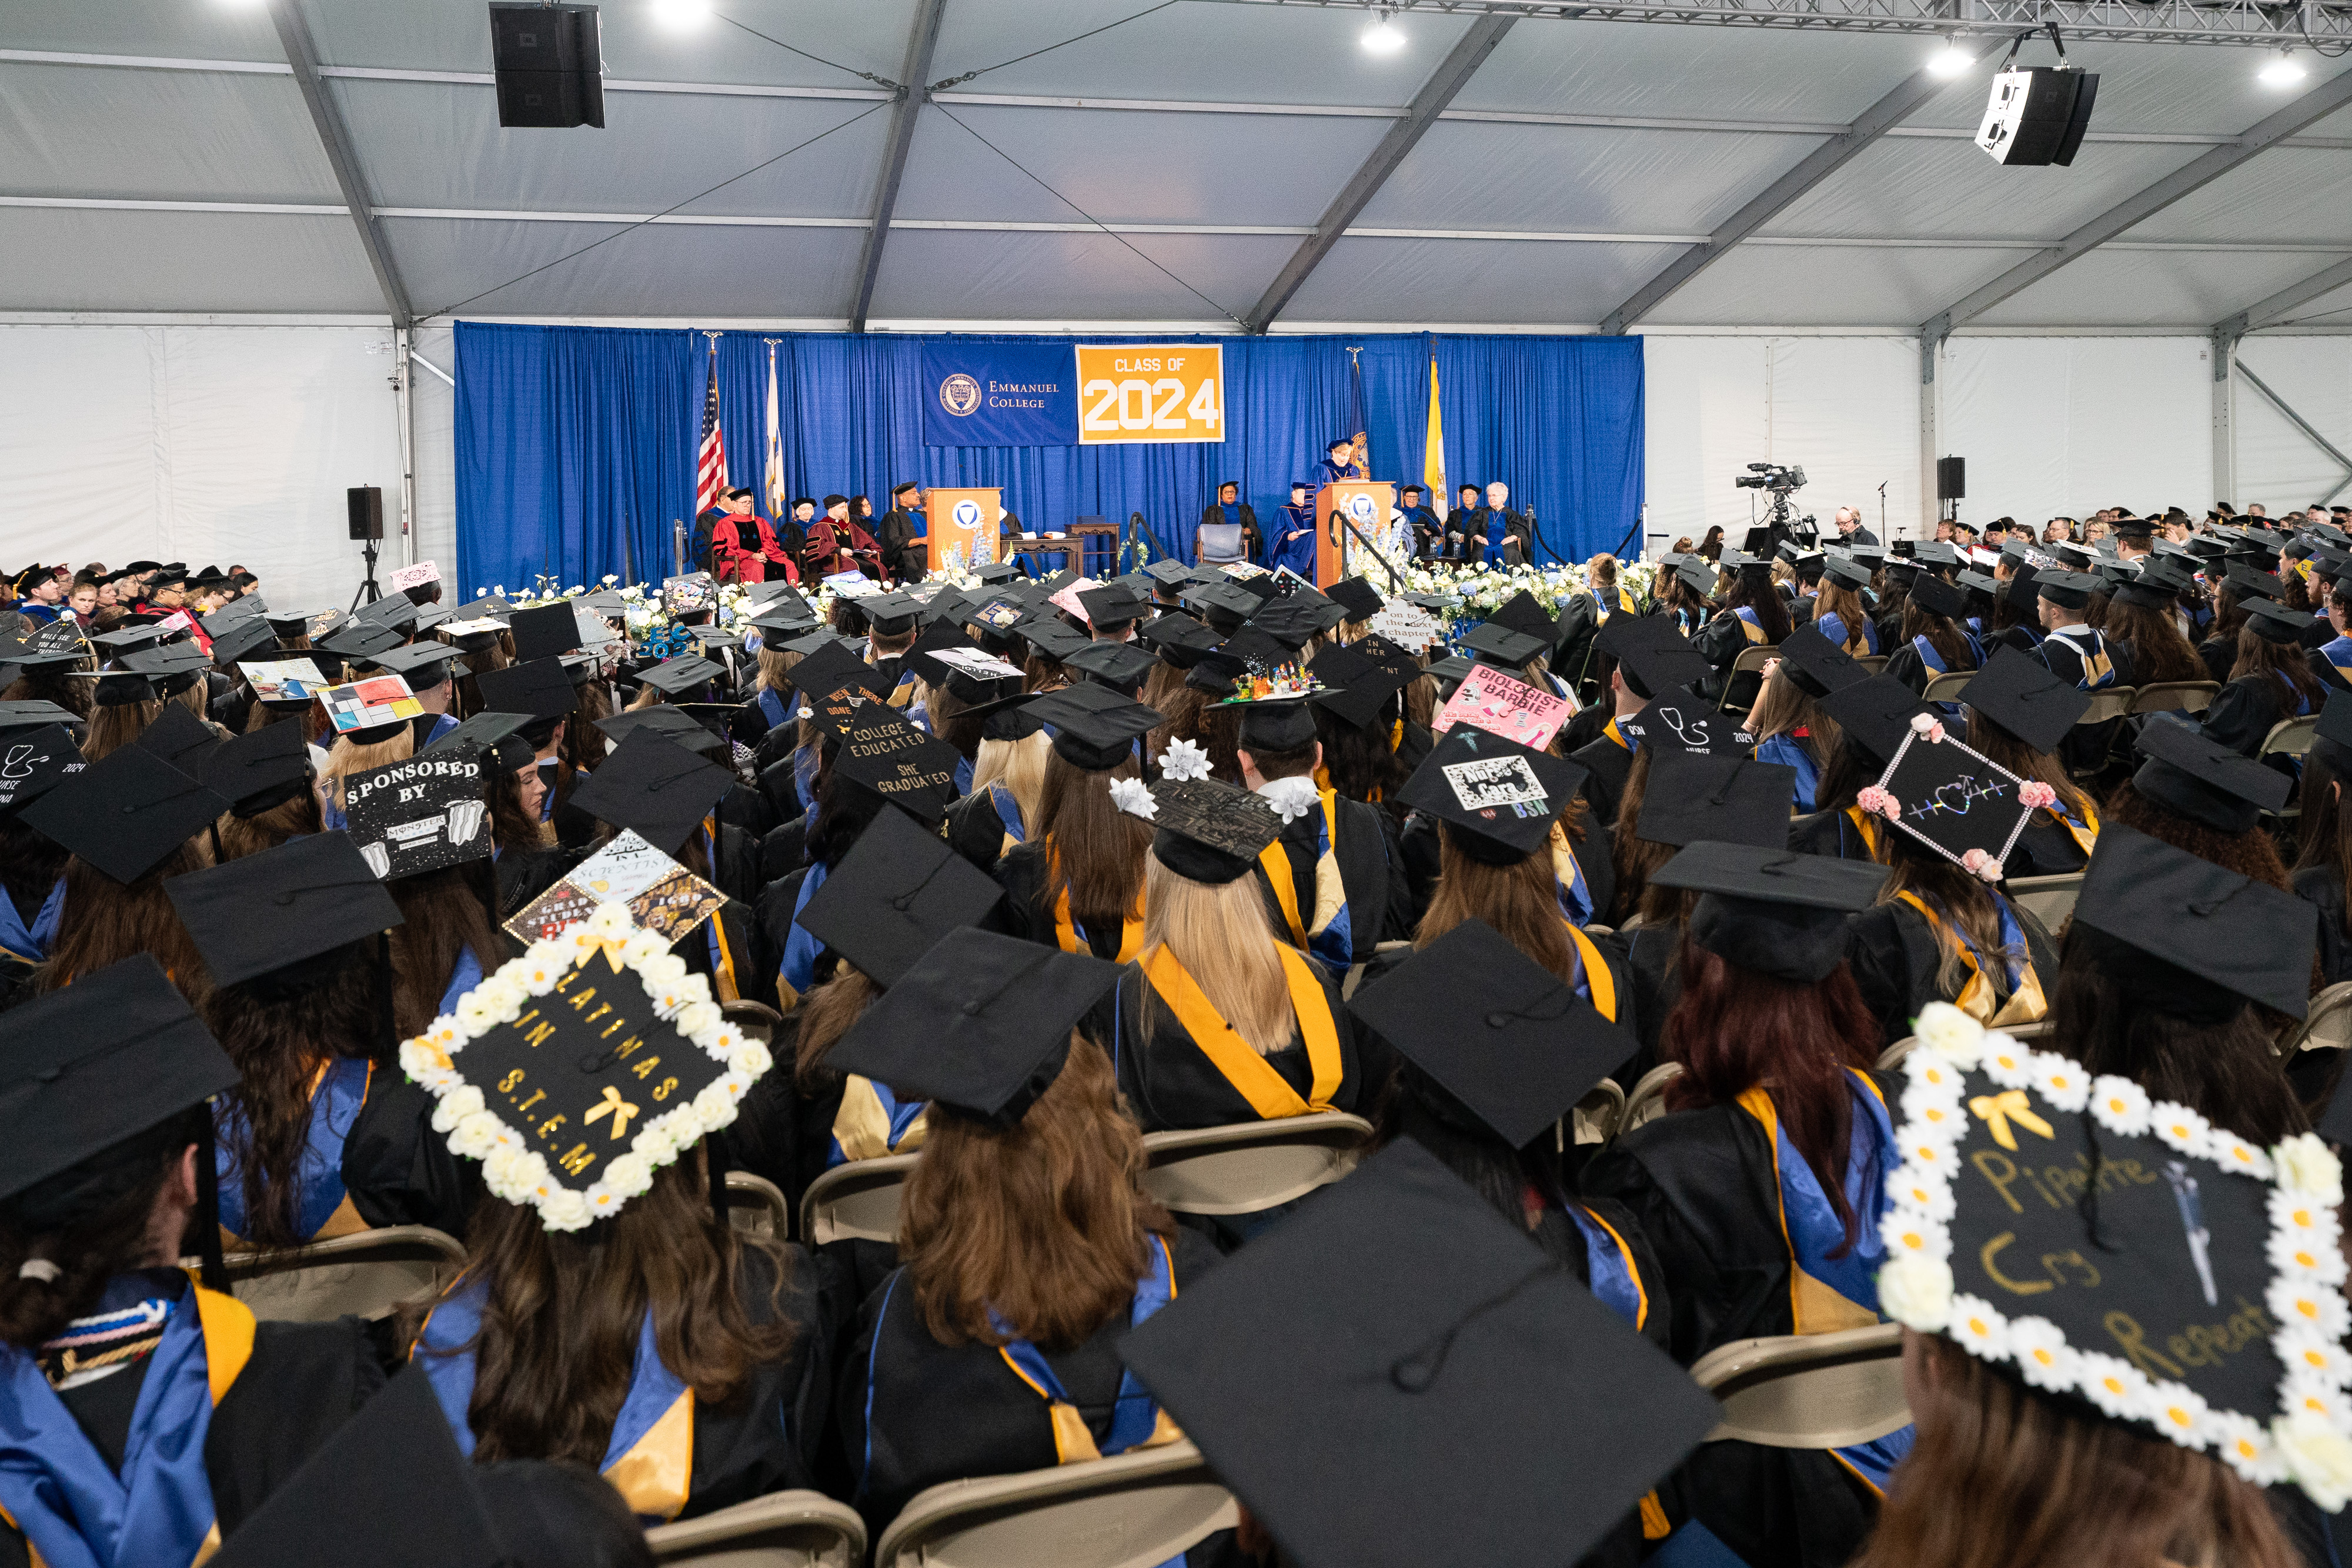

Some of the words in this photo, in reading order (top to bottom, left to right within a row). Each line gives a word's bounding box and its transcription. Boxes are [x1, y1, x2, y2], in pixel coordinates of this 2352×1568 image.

[1115, 358, 1161, 372] CLASS
[1167, 357, 1186, 372] OF
[989, 380, 1059, 393] EMMANUEL
[989, 396, 1045, 408] COLLEGE
[1084, 378, 1219, 431] 2024
[650, 621, 691, 644] EC
[636, 640, 706, 659] 2024
[1366, 648, 1385, 656] HER
[828, 688, 851, 702] BEEN
[858, 687, 884, 706] THERE
[1478, 668, 1563, 710] BIOLOGIST
[1484, 683, 1546, 717] BARBIE
[827, 707, 852, 715] DONE
[854, 723, 906, 742] COLLEGE
[1628, 726, 1646, 735] BSN
[1733, 733, 1754, 743] 2024
[850, 733, 925, 757] EDUCATED
[62, 763, 86, 773] 2024
[897, 763, 920, 776] SHE
[0, 780, 21, 790] URSE
[347, 761, 479, 805] SPONSORED
[878, 772, 950, 793] GRADUATED
[1477, 783, 1517, 796] Cara
[398, 784, 426, 803] BY
[1511, 799, 1551, 819] BSN
[389, 817, 444, 836] MONSTER
[578, 858, 668, 879] SCIENTIST
[527, 907, 595, 928] STUDEN
[513, 1009, 556, 1047] IN
[556, 971, 680, 1102] LATINAS
[1980, 1231, 2102, 1295] Cry
[2103, 1295, 2274, 1383] Repeat
